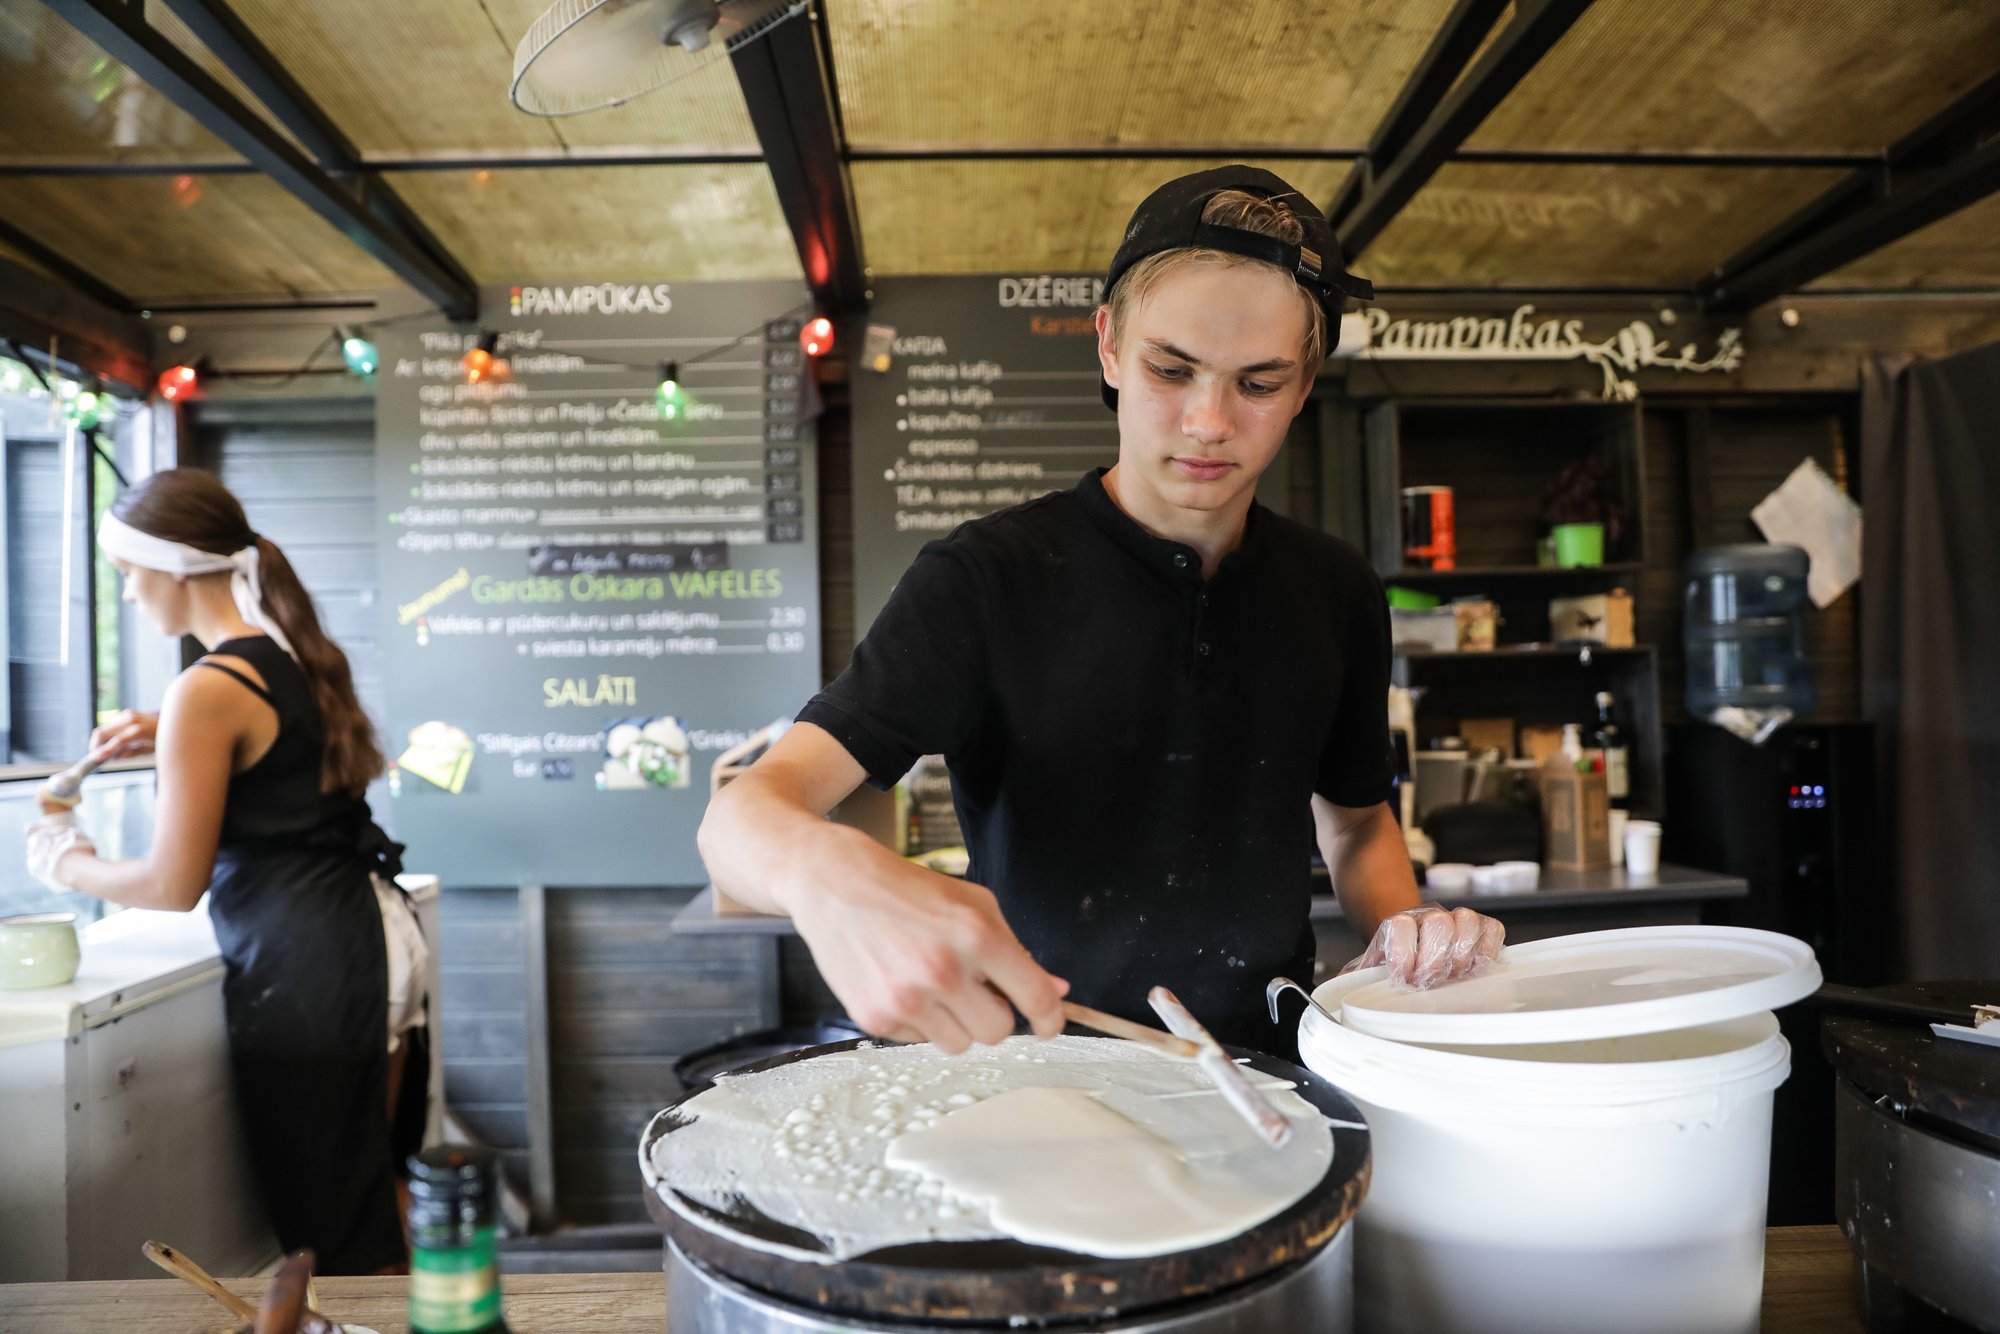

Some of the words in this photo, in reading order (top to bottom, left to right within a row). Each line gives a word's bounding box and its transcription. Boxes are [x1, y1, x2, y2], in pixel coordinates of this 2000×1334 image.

[521, 282, 672, 316] PAMPŪKAS
[998, 275, 1107, 308] DZĒRIEN
[668, 567, 784, 600] VAFELES
[543, 674, 637, 709] SALĀTI
